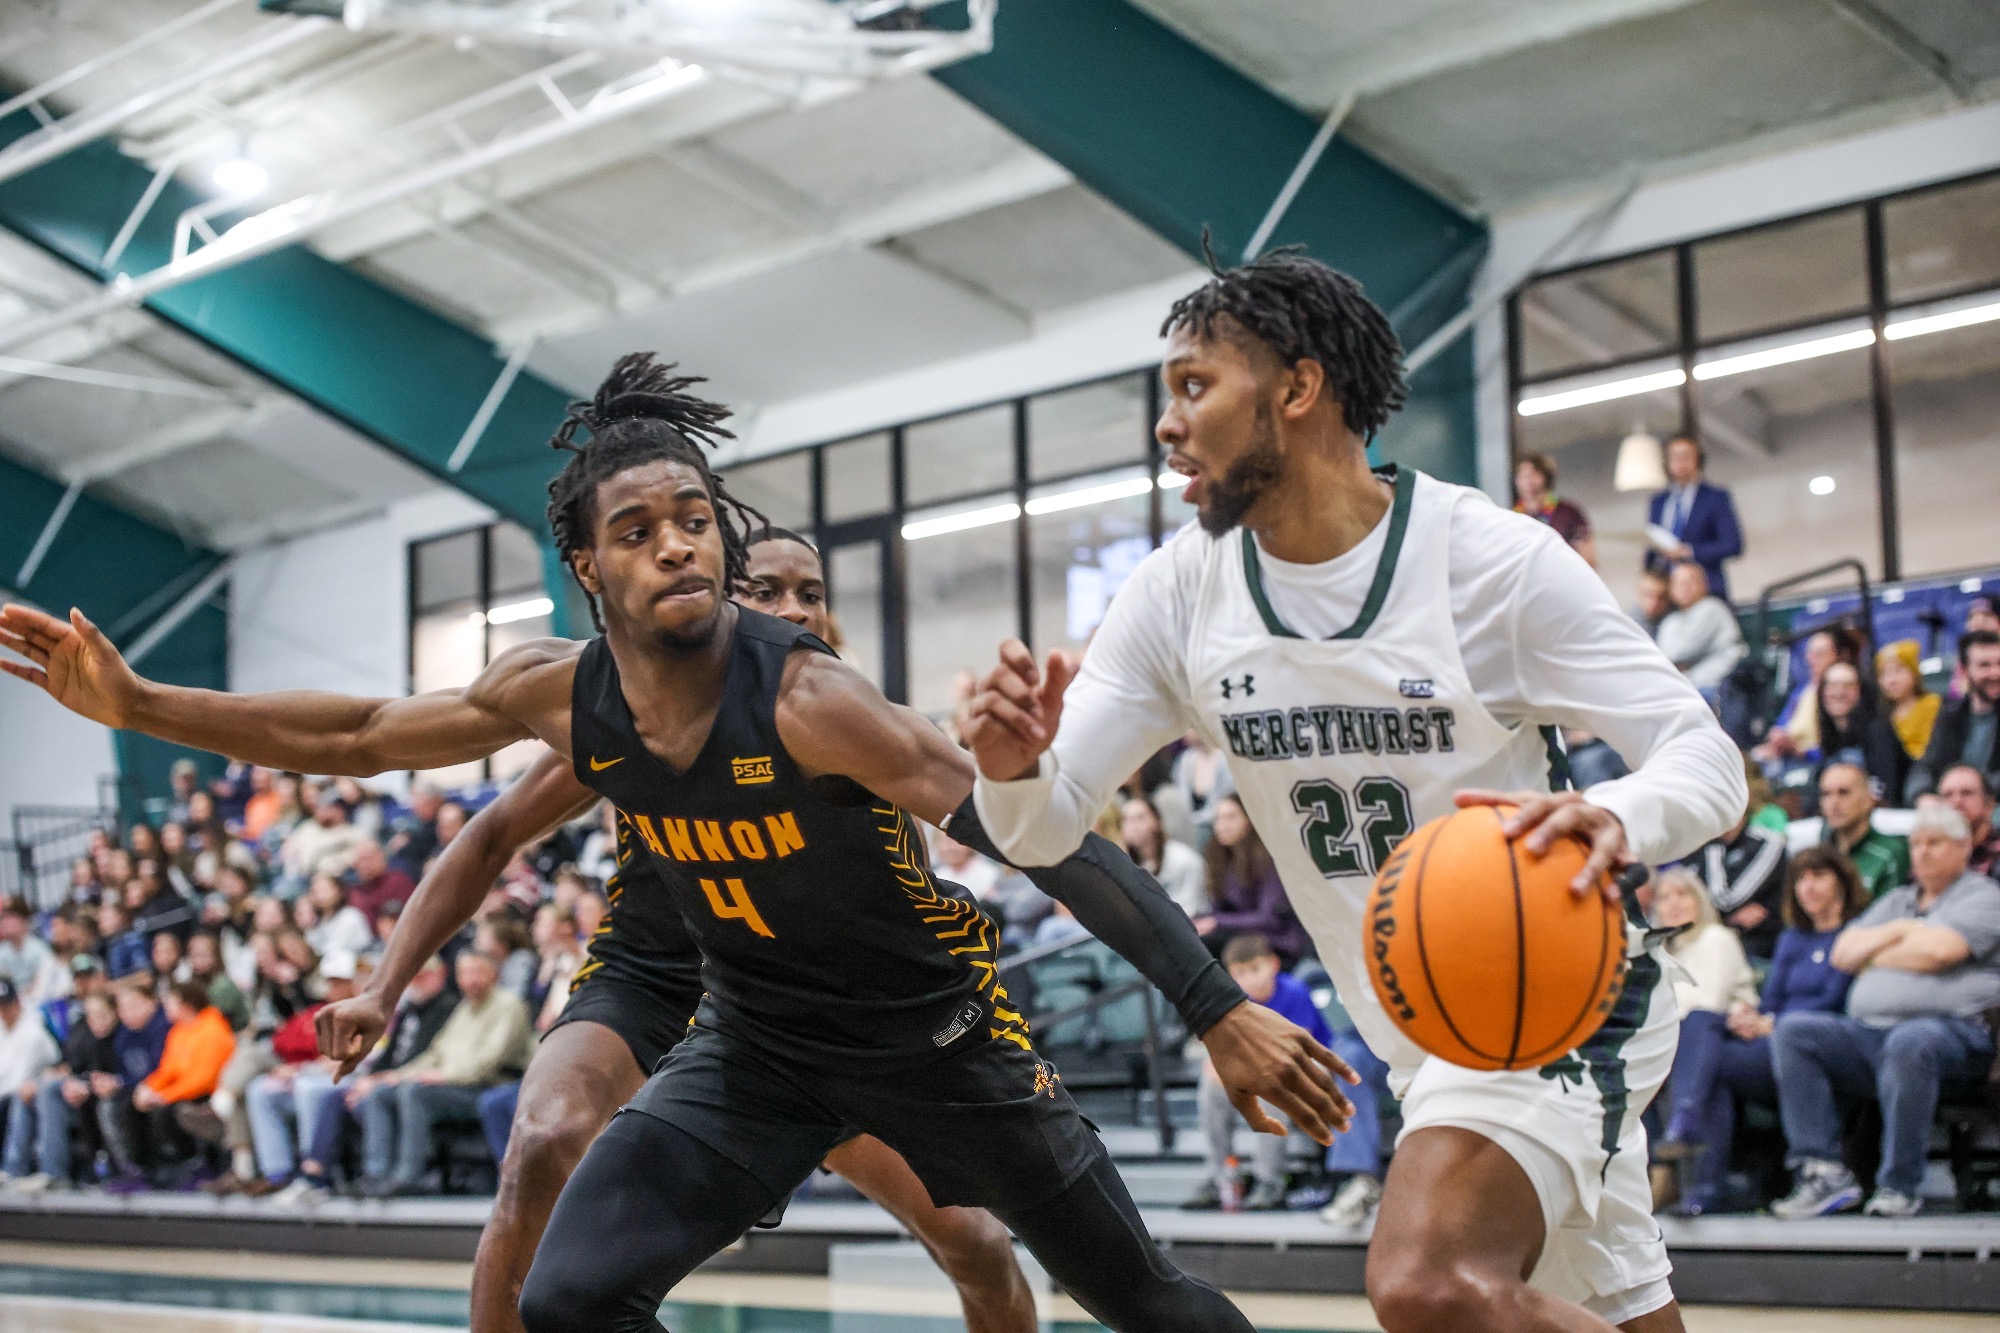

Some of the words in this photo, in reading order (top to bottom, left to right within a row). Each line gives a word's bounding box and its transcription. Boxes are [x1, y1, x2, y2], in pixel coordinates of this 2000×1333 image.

[1221, 705, 1455, 761] MERCYHURST
[733, 762, 774, 778] PSAC
[617, 808, 806, 861] ANNON
[1290, 776, 1415, 879] 22
[699, 878, 776, 939] 4
[964, 1008, 976, 1022] M
